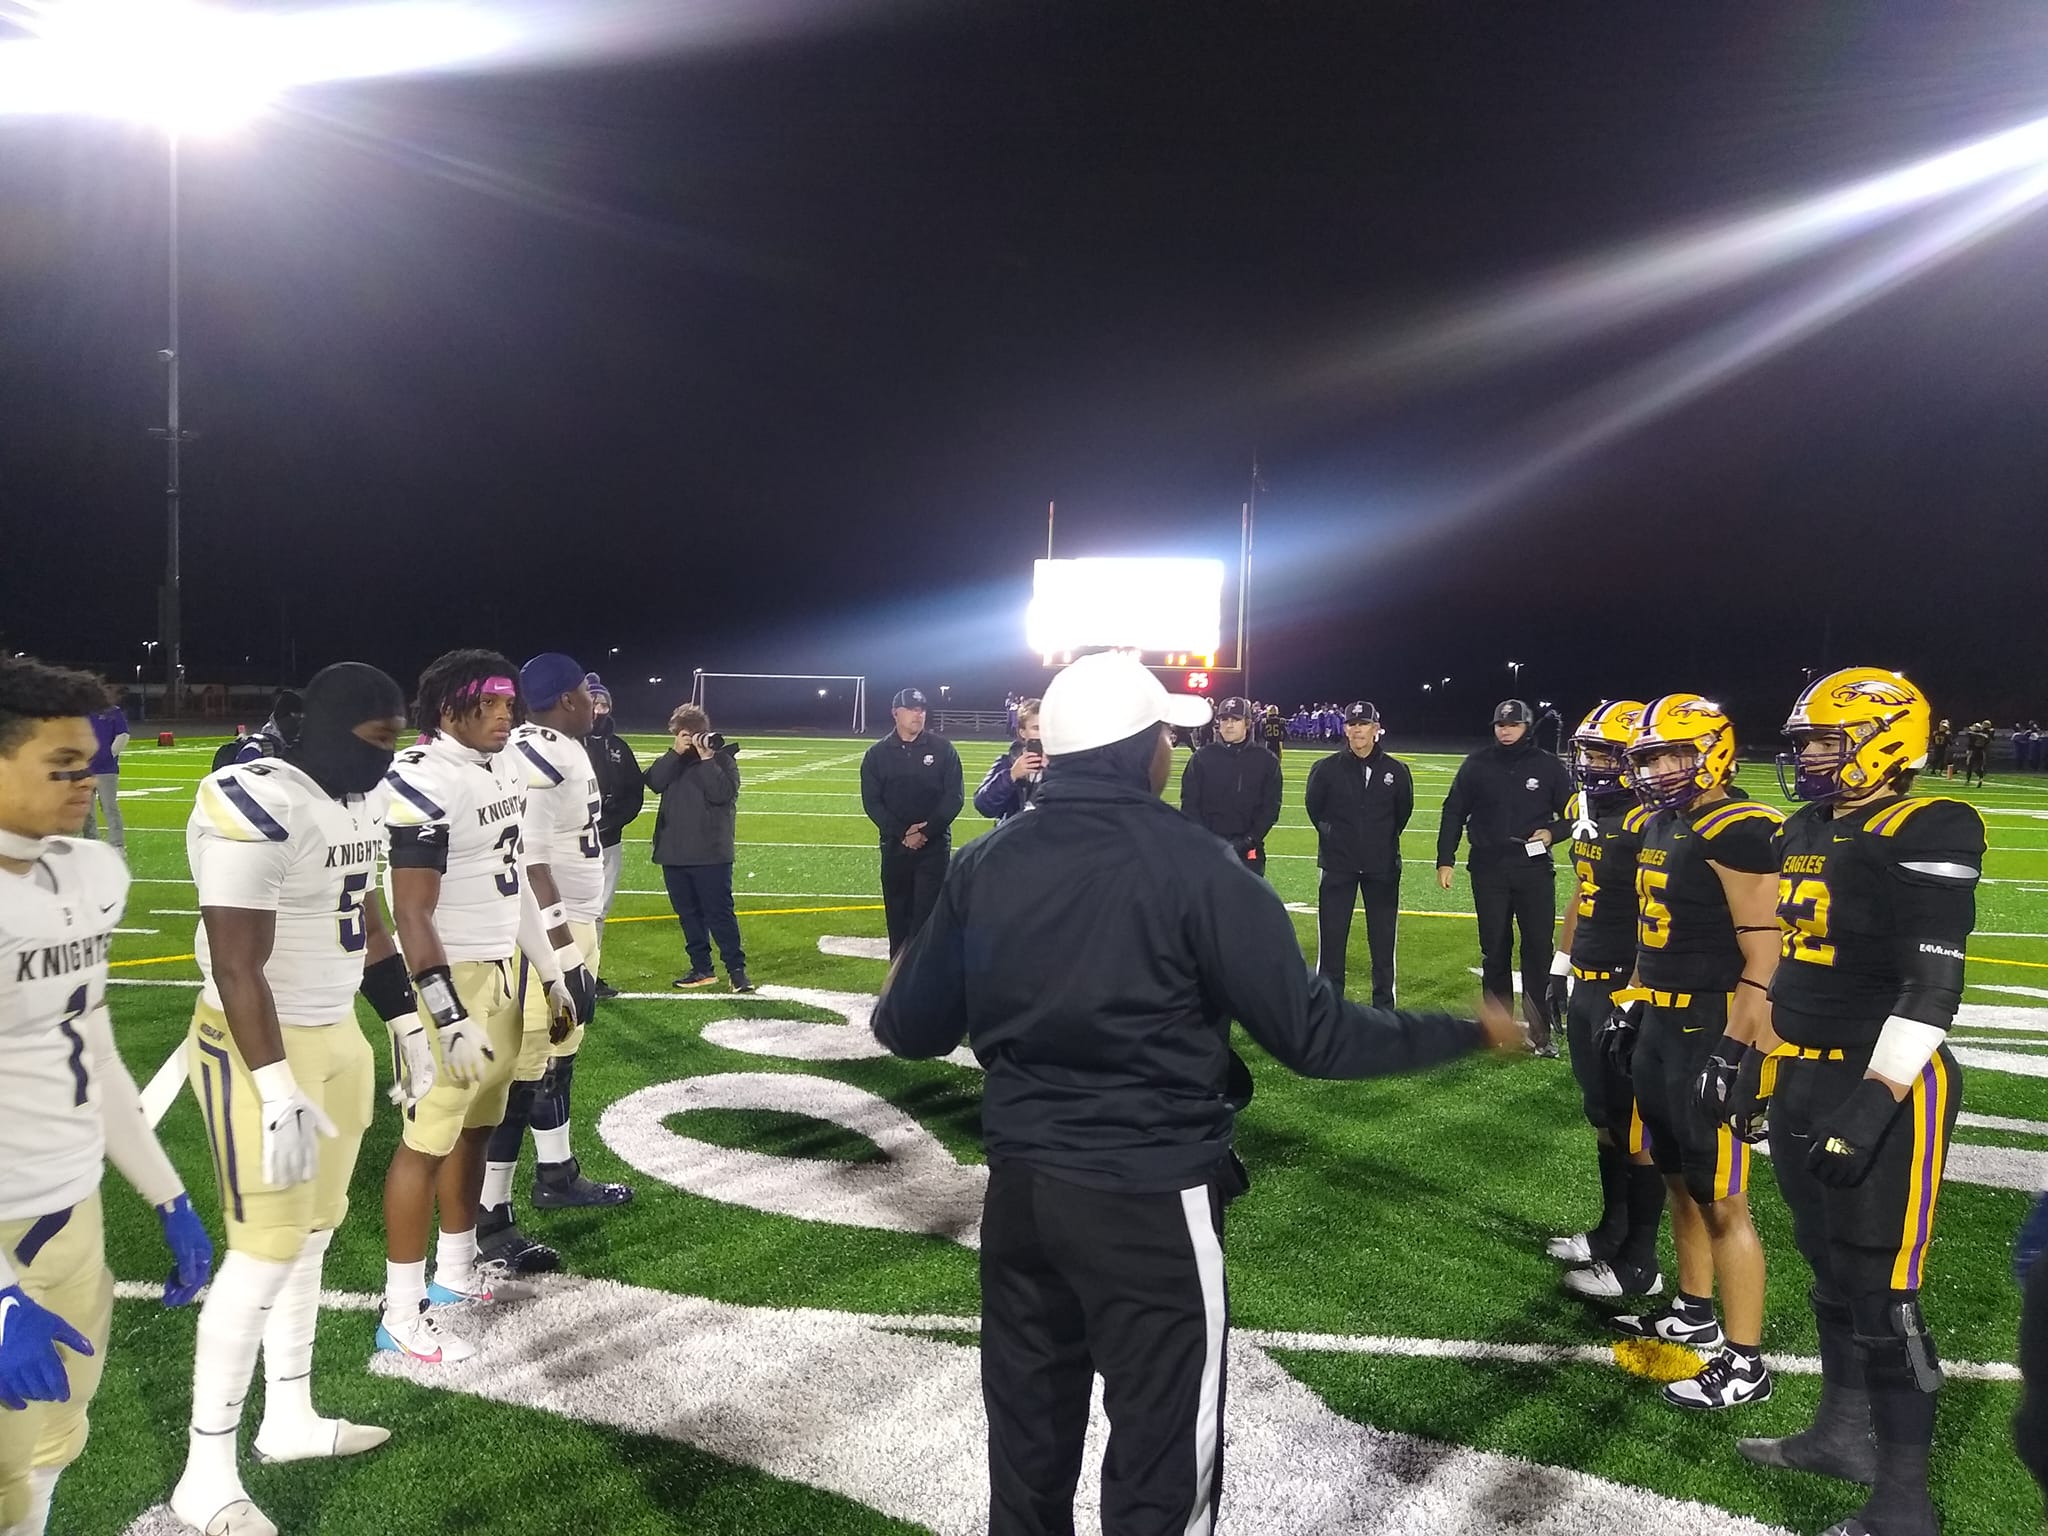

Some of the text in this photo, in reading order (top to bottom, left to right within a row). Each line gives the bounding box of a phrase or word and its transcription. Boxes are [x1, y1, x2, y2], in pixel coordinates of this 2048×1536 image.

[1188, 672, 1209, 688] 25
[519, 727, 557, 742] 50
[1265, 724, 1280, 736] 26
[398, 750, 426, 765] 3
[241, 763, 279, 776] 5
[1574, 841, 1602, 861] EAGLES
[493, 824, 520, 898] 3
[1782, 855, 1827, 874] EAGLES
[1576, 859, 1600, 918] 2
[339, 871, 368, 953] 5
[1635, 867, 1672, 949] 5
[60, 983, 90, 1108] 1
